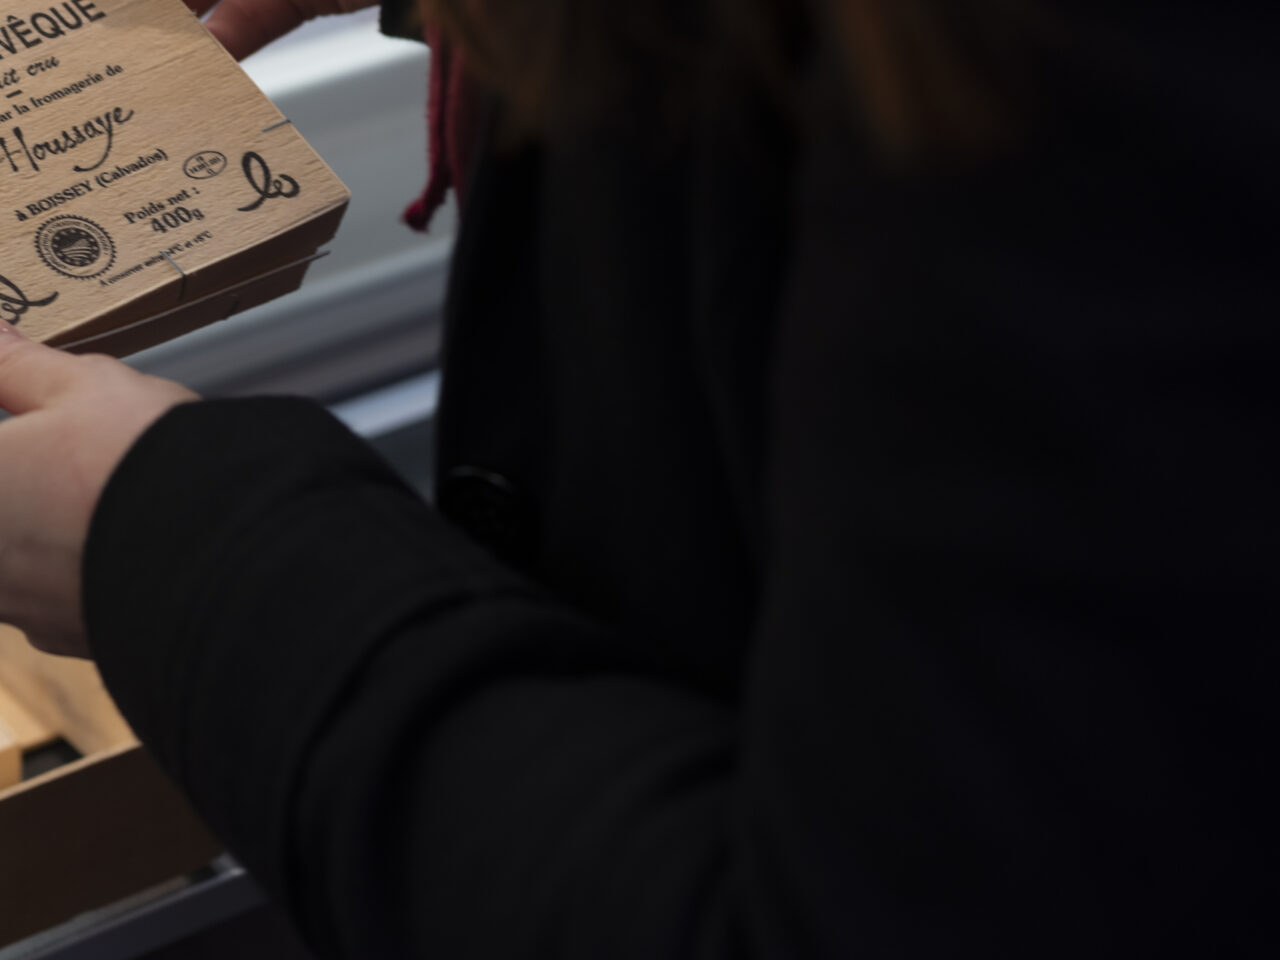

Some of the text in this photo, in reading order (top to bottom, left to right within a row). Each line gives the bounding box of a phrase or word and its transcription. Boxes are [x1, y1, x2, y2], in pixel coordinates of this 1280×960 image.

[26, 56, 60, 77] cru
[12, 103, 31, 116] la
[29, 72, 104, 109] fromagerie
[105, 62, 124, 77] de
[15, 209, 29, 222] à
[25, 180, 95, 217] BOISSEY
[95, 148, 169, 188] (Calvados)
[123, 201, 166, 224] Poids
[167, 190, 191, 207] net
[150, 206, 206, 234] 400g
